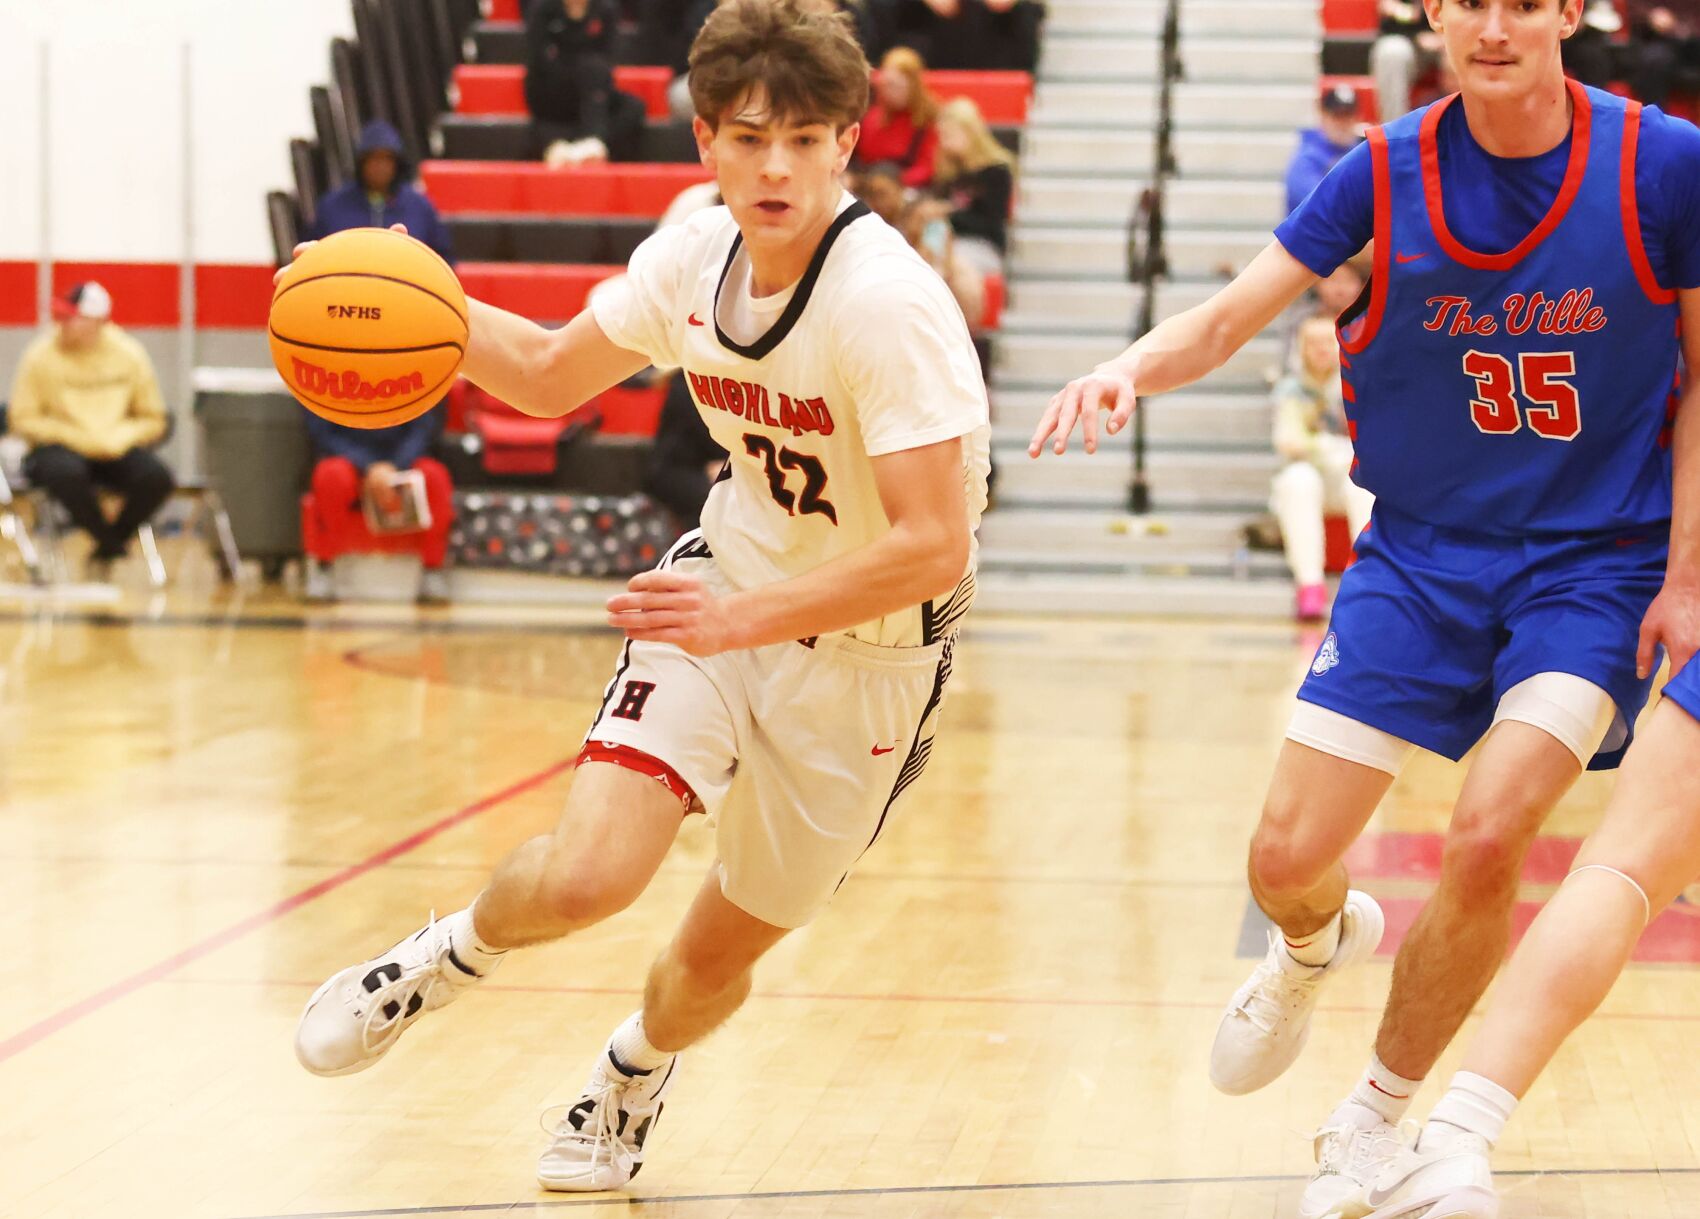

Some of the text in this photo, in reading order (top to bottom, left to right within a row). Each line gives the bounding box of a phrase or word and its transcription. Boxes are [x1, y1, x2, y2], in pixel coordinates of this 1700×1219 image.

[338, 305, 382, 320] NFHS
[1423, 287, 1608, 336] The Ville
[291, 356, 425, 401] Wilson
[1462, 349, 1582, 442] 35
[687, 371, 835, 437] HIGHLAND
[742, 433, 838, 527] 22
[611, 680, 657, 722] H
